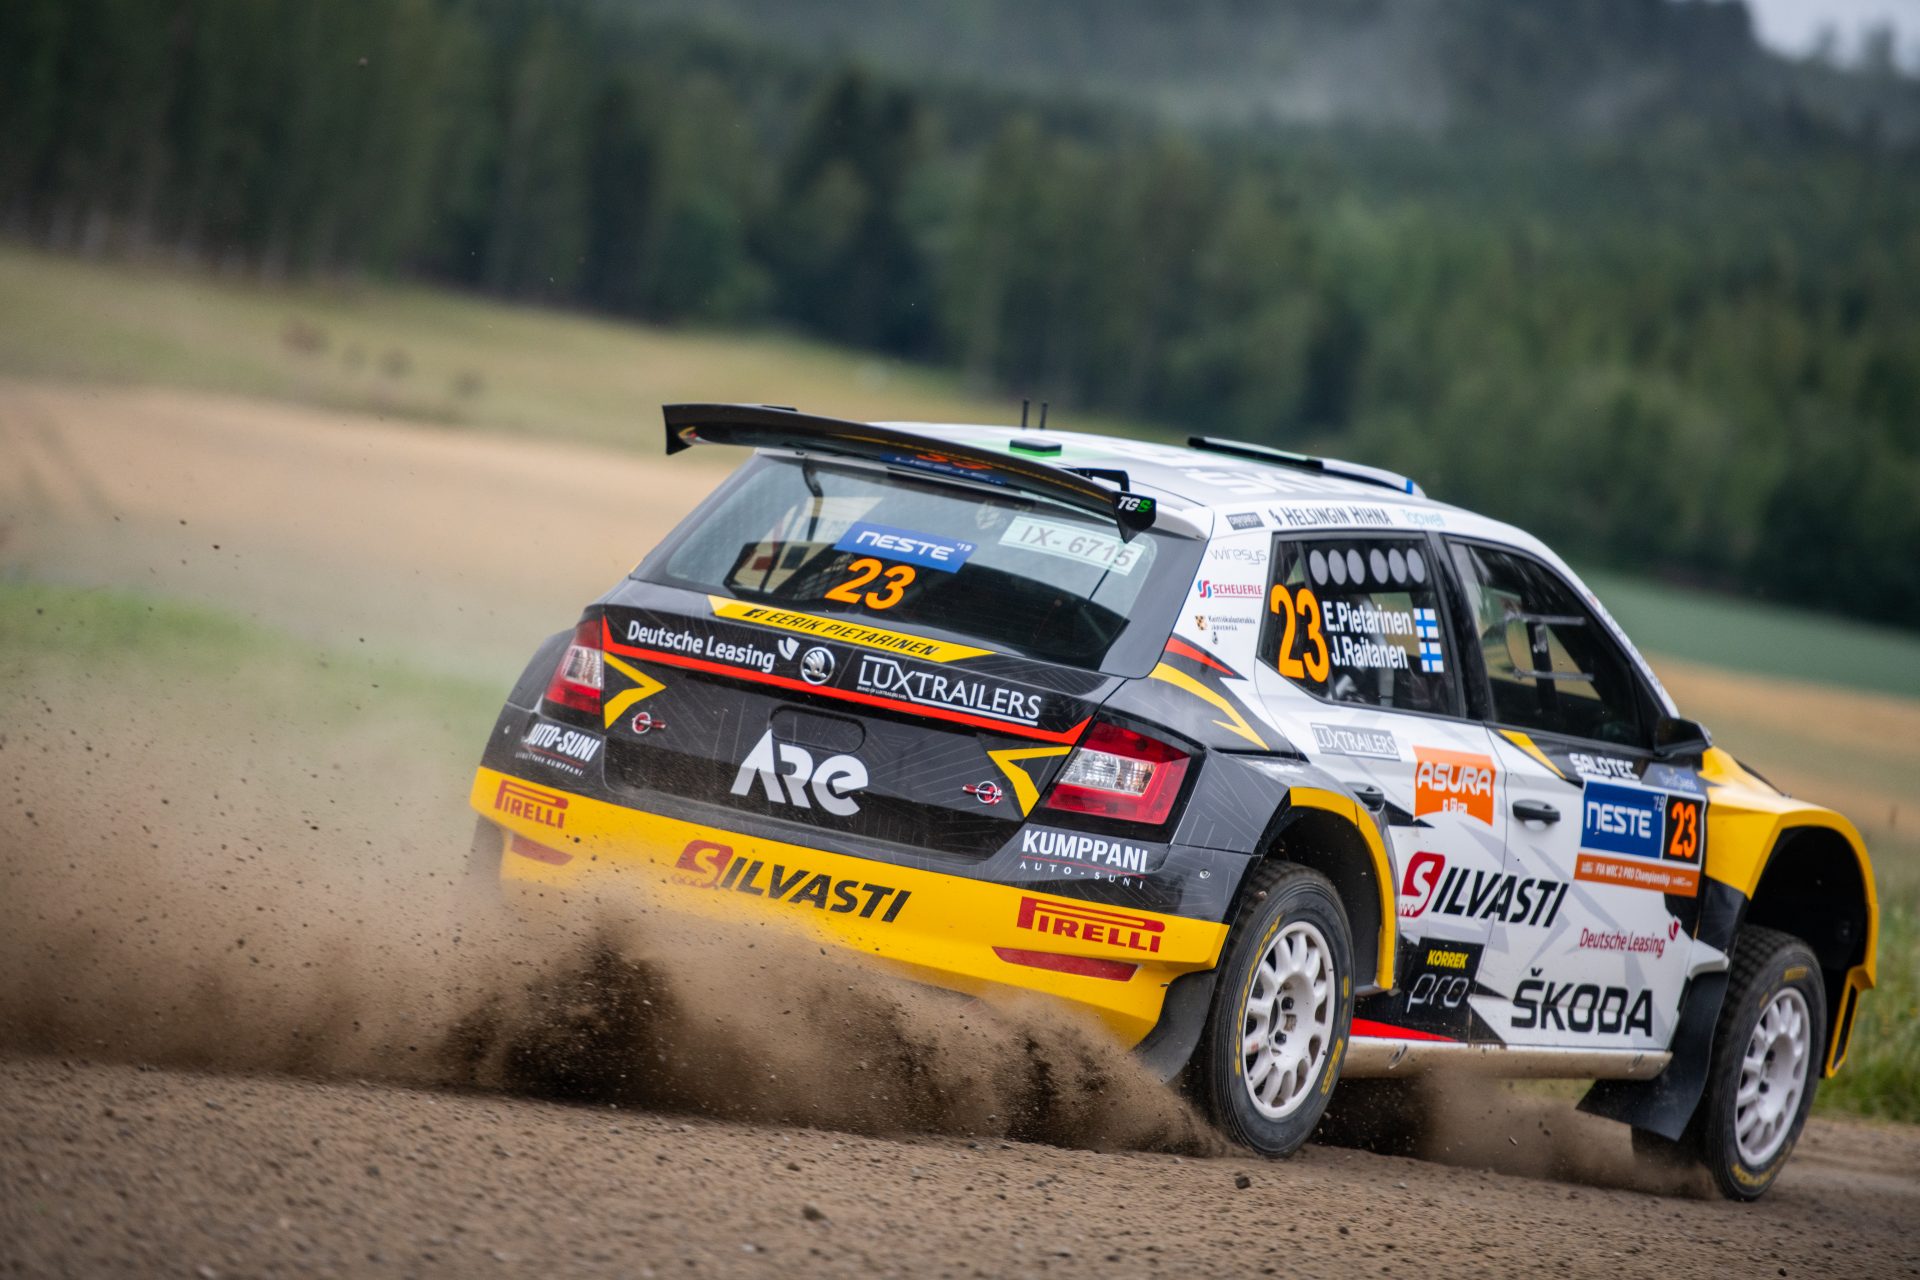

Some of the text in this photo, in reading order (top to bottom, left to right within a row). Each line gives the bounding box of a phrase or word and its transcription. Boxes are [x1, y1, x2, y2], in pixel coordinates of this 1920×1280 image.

[1117, 495, 1152, 513] TGS
[1280, 506, 1351, 527] HELSINGIN
[1350, 506, 1394, 526] HIHNA
[824, 557, 916, 611] 23
[1212, 583, 1262, 596] SCHEUERLE
[766, 611, 941, 657] EERIK PIETARINEN
[1270, 584, 1330, 683] 23
[1322, 600, 1413, 636] E.Pietarinen
[627, 620, 776, 674] Deutsche Leasing
[1331, 636, 1408, 670] J.Raitanen
[858, 656, 1042, 722] LUXTRAILERS
[1313, 724, 1399, 758] LUXTRAILERS
[1417, 761, 1491, 798] ASURA
[494, 779, 569, 829] PIRELLI
[1021, 829, 1148, 873] KUMPPANI
[1670, 801, 1698, 859] 23
[676, 840, 912, 924] SILVASTI
[1402, 851, 1569, 928] SILVASTI
[1017, 896, 1166, 953] PIRELLI
[1579, 928, 1665, 960] Deutsche Leasing
[1426, 949, 1469, 970] KORREK
[1406, 973, 1470, 1013] pro
[1511, 967, 1654, 1038] ŠKODA
